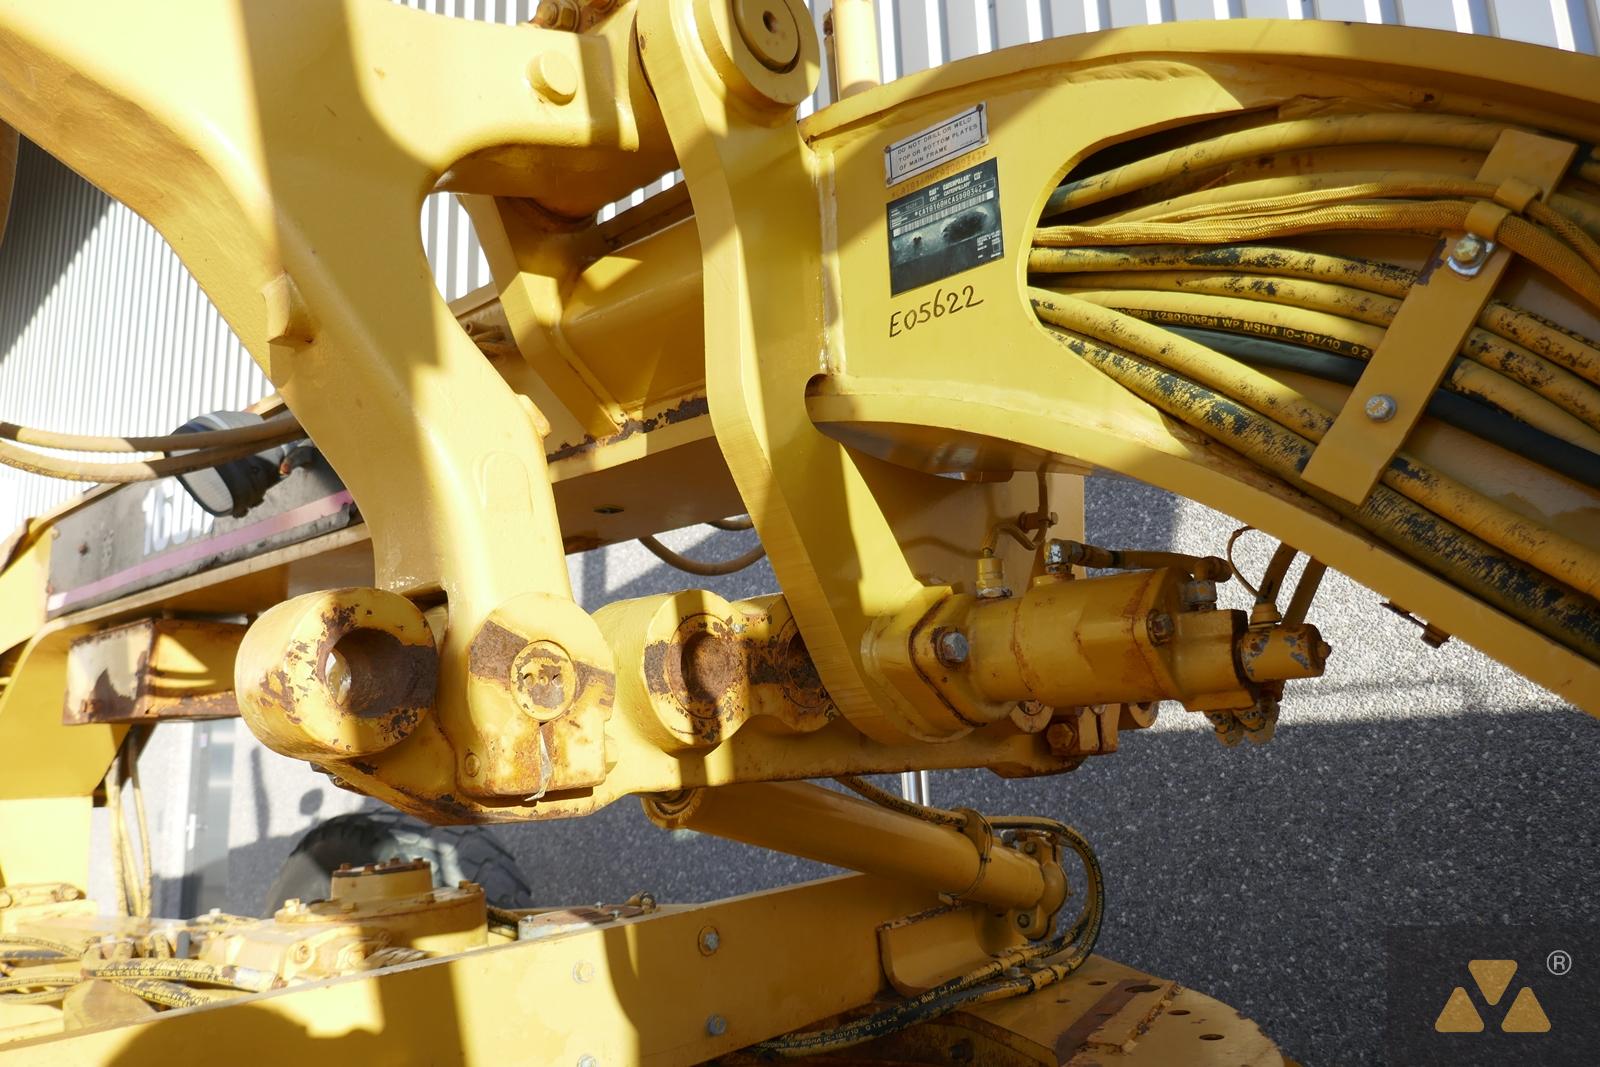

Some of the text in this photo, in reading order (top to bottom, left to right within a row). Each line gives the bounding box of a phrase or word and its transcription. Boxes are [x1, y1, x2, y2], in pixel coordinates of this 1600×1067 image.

[897, 116, 972, 155] DO NOT DRILL OR WELD
[898, 153, 911, 163] TOP
[911, 149, 921, 157] OR
[923, 135, 950, 152] BOTTOM
[951, 123, 978, 138] PLATES
[898, 145, 948, 172] OF MAIN FRAME
[1222, 318, 1240, 328] WP
[1243, 321, 1278, 335] MSHA
[1282, 328, 1341, 350] IC-101/10
